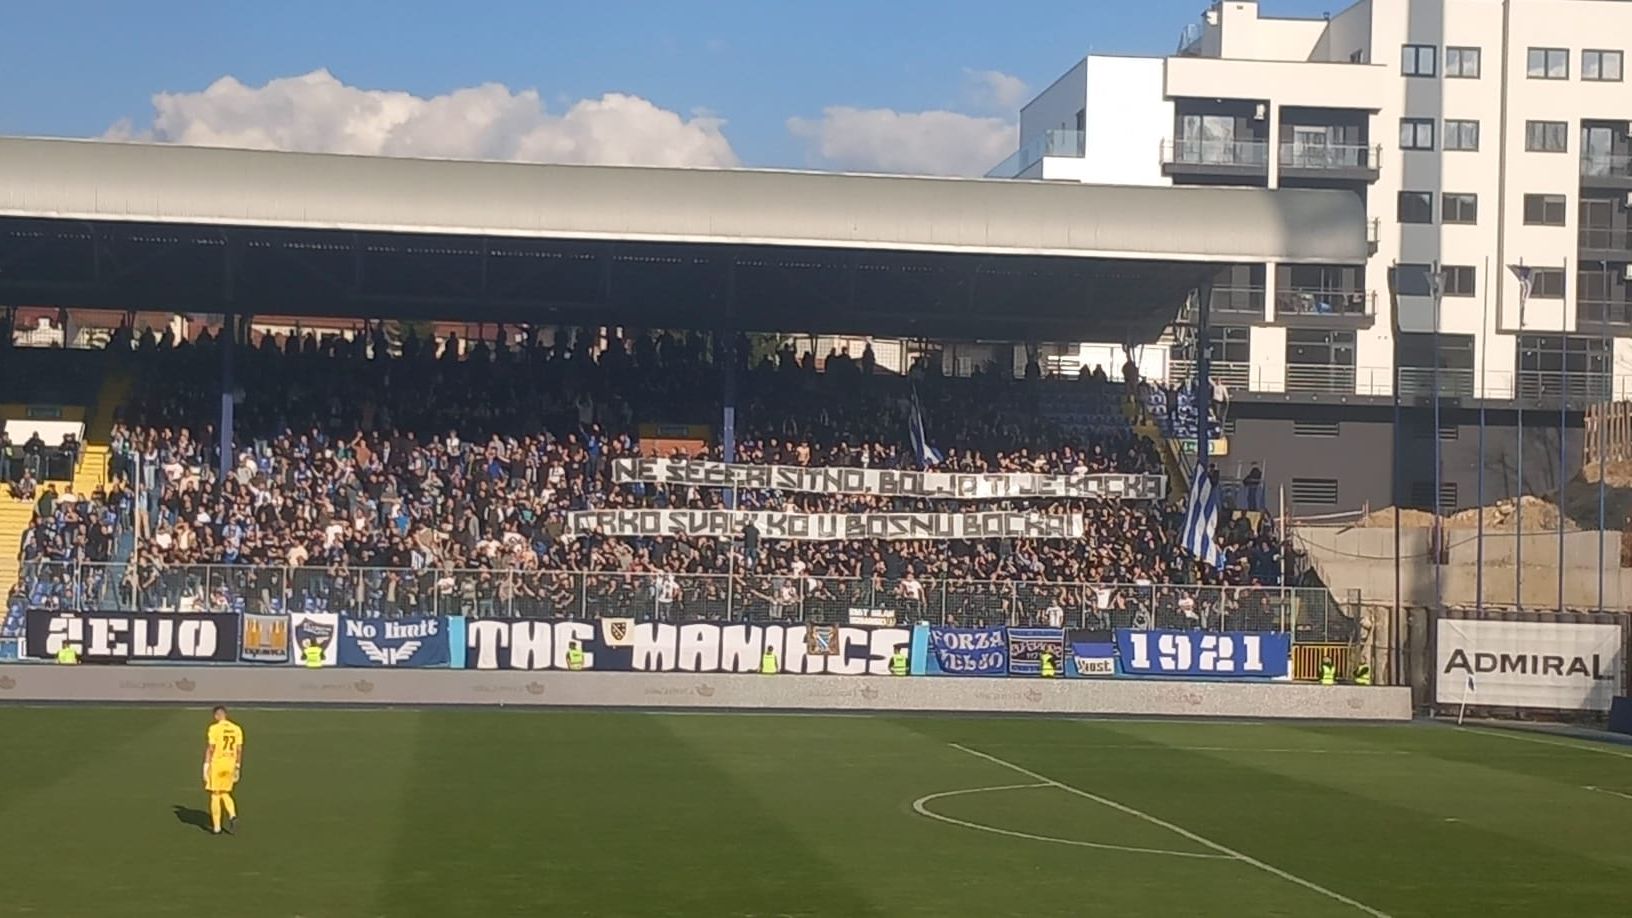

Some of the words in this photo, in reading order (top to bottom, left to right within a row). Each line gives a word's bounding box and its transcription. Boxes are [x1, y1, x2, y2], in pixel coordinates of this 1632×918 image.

[615, 459, 657, 481] NE
[1019, 475, 1057, 495] JE
[573, 511, 661, 533] CRKO
[766, 513, 809, 536] KO
[818, 515, 837, 537] U
[845, 515, 954, 537] BOSNU
[346, 619, 377, 638] No
[384, 619, 440, 639] limit
[931, 630, 1005, 651] FORZA
[468, 620, 594, 670] THE
[632, 622, 910, 675] MANIACS
[1130, 633, 1263, 671] 1921
[1444, 649, 1615, 681] ADMIRAL
